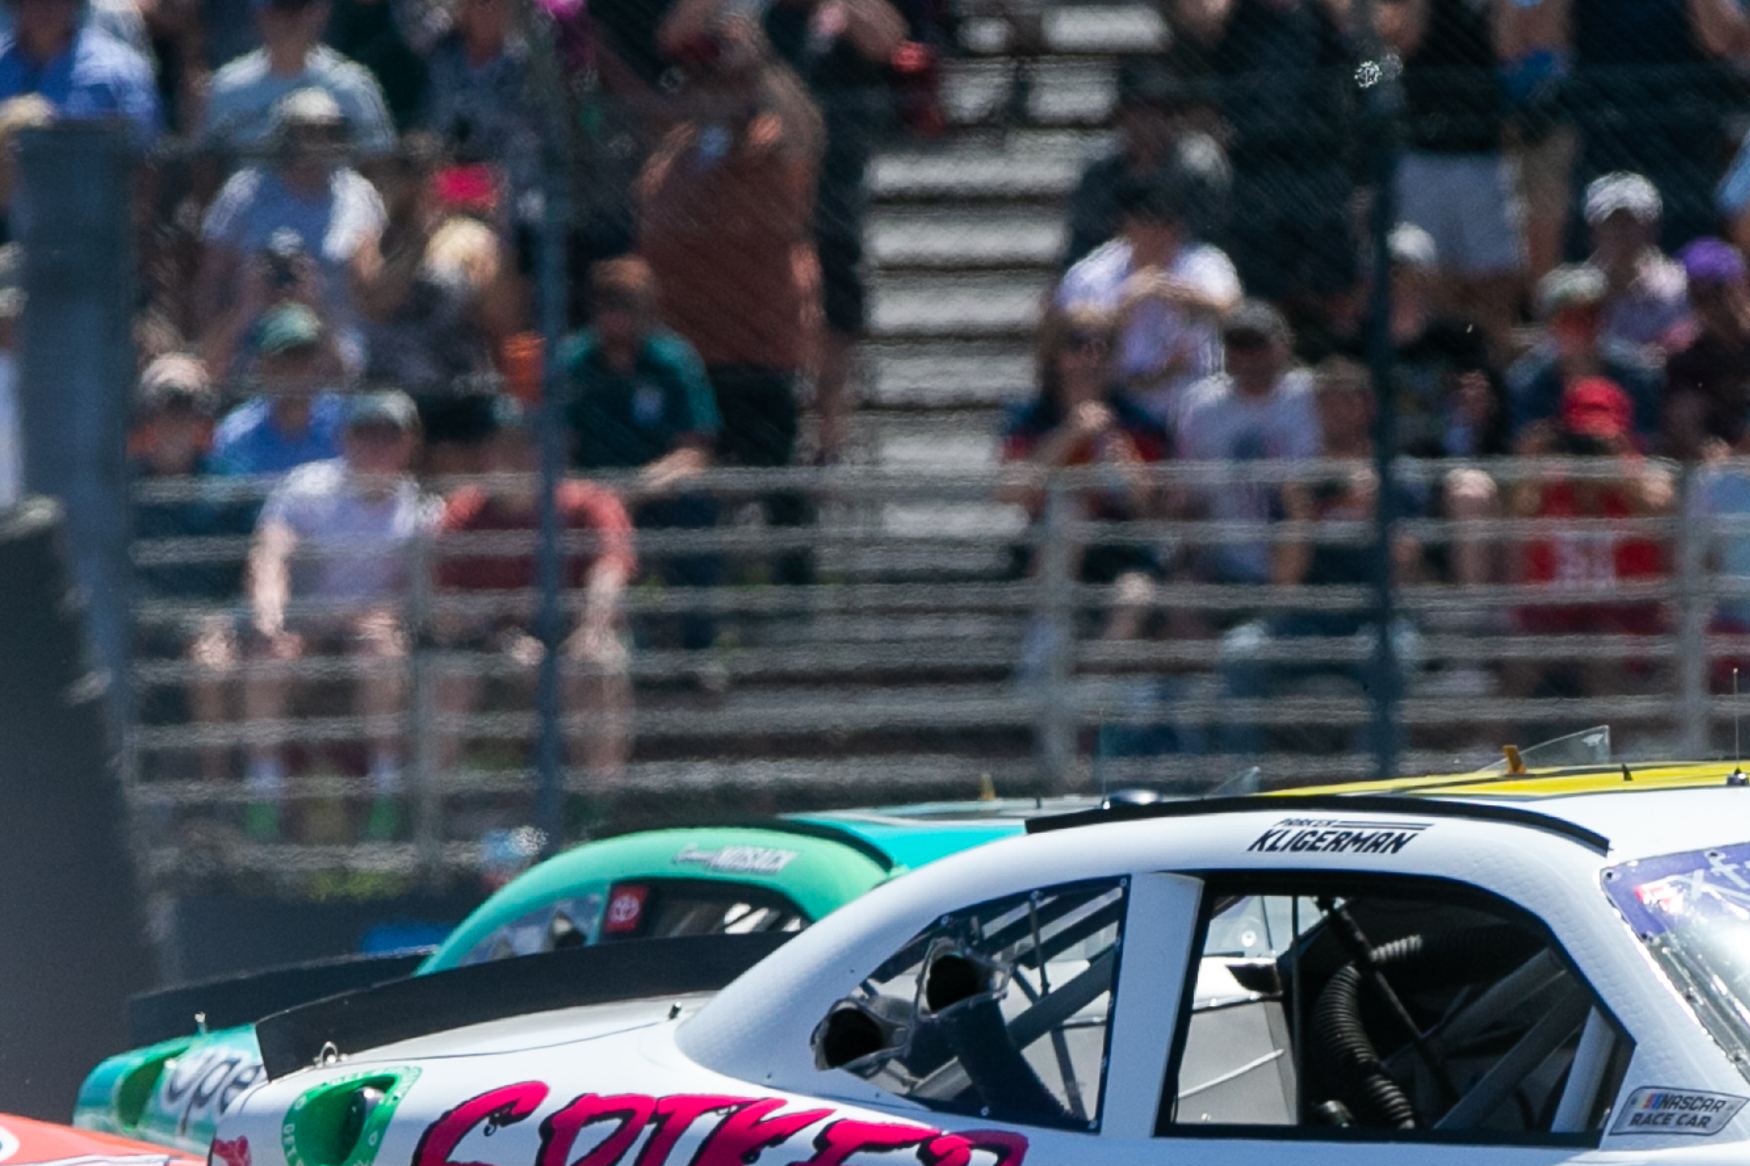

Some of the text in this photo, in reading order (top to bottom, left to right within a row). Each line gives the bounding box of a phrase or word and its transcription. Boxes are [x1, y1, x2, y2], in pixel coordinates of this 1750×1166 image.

[1248, 829, 1419, 854] KLIGERMAN
[1657, 1093, 1727, 1113] NASCAR
[1629, 1112, 1711, 1128] RACE CAR
[283, 1123, 298, 1158] GET
